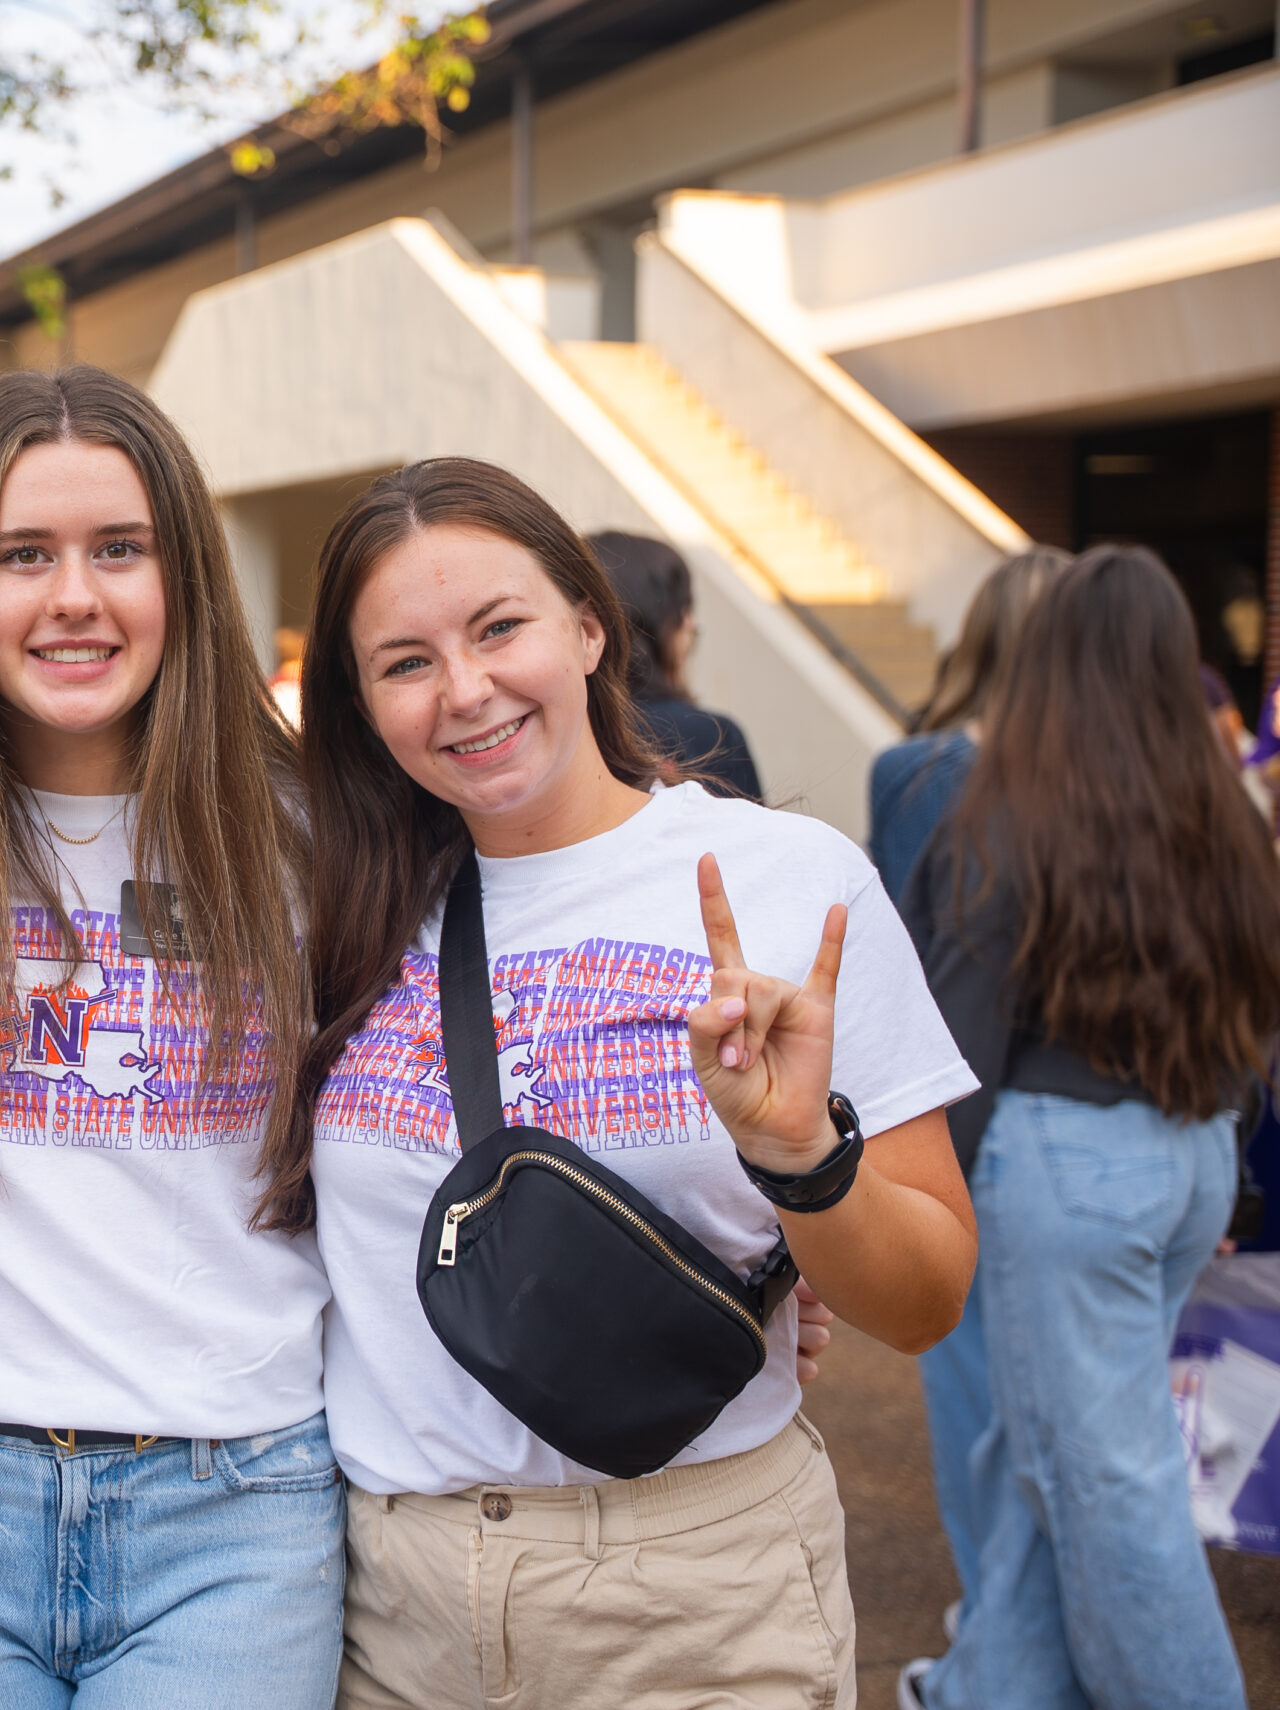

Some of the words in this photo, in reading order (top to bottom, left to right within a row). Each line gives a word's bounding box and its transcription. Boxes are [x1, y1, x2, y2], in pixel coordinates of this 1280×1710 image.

[562, 936, 714, 988] UNIVERSIT
[532, 1040, 692, 1082] UNIVERSIT
[54, 1096, 134, 1134] STATE
